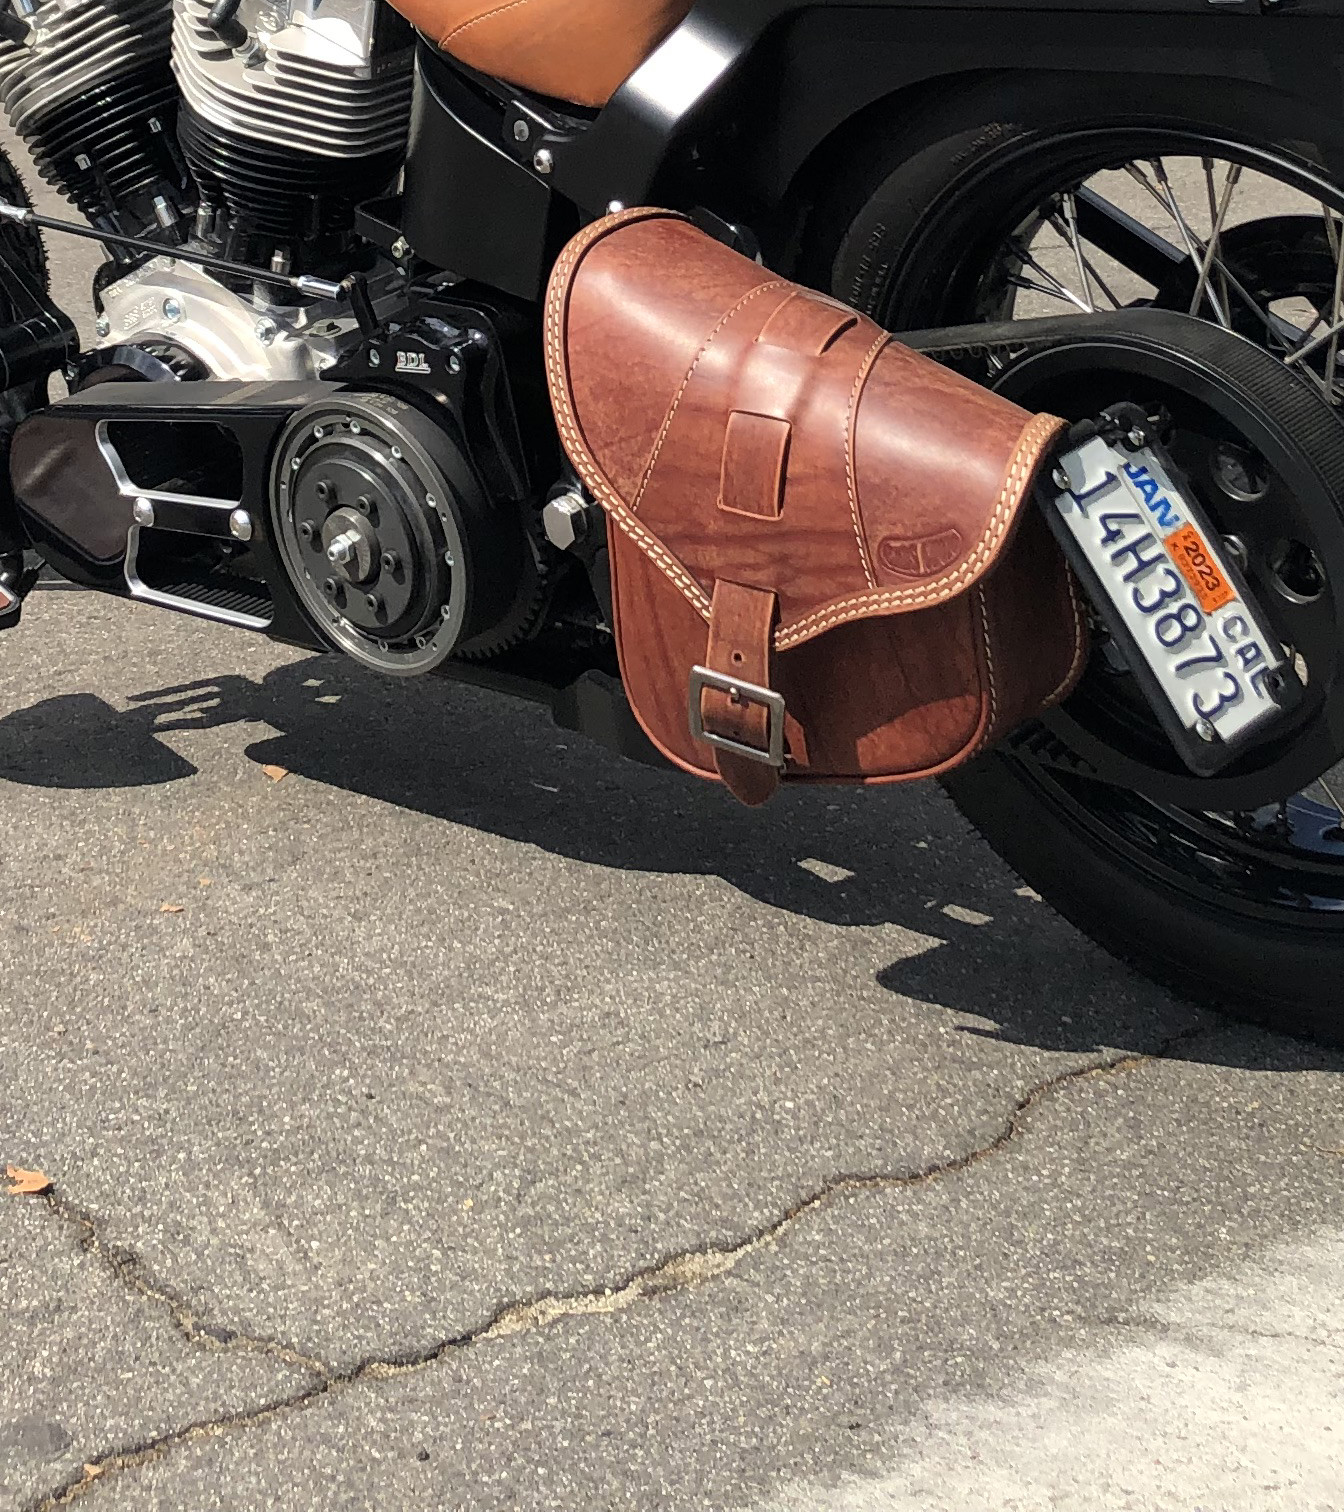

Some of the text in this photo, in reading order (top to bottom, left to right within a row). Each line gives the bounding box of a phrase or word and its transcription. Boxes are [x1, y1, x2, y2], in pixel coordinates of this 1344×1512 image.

[396, 351, 429, 368] BDL
[1122, 462, 1180, 527] JAN
[1066, 471, 1240, 720] 14H3873
[1183, 541, 1220, 592] 2023
[1223, 615, 1268, 700] CAL
